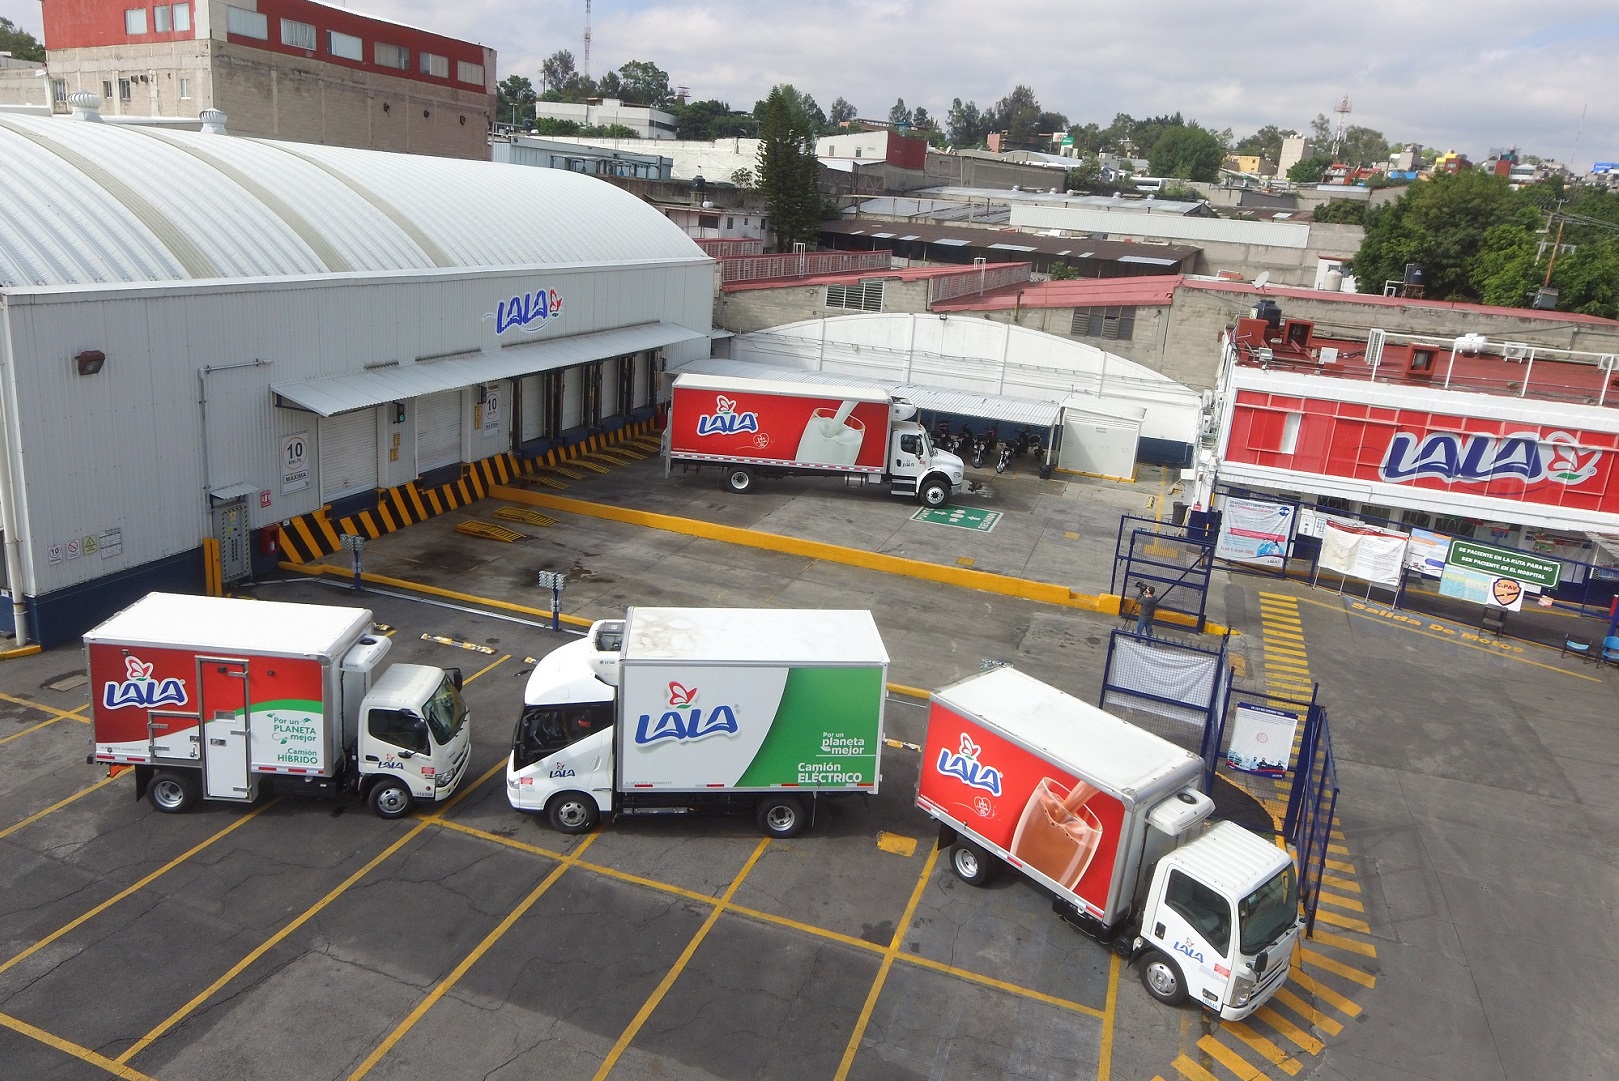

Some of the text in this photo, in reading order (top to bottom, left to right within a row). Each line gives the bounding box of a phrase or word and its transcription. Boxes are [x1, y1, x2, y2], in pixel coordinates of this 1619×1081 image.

[496, 288, 548, 335] LALA
[487, 398, 497, 411] 10
[698, 412, 758, 435] LALA
[287, 442, 303, 459] 10
[1382, 434, 1545, 480] LALA
[51, 547, 60, 555] 10
[1467, 549, 1493, 559] PACIENTE
[1474, 559, 1500, 569] PACIENTE
[1517, 569, 1546, 579] HOSPITAL
[1352, 602, 1524, 653] Salida De Motos
[105, 679, 187, 708] LALA
[274, 716, 287, 724] Por
[635, 705, 738, 744] LALA
[274, 724, 316, 735] PLANETA
[290, 734, 316, 743] mejor
[822, 737, 865, 747] planeta
[287, 747, 317, 756] Camión
[831, 746, 865, 756] mejor
[277, 752, 318, 764] HÍBRIDO
[378, 761, 404, 769] LALA
[797, 762, 841, 772] Camión
[549, 769, 576, 778] LALA
[797, 771, 863, 783] ELÉCTRICO
[938, 749, 1001, 795] LALA
[1173, 941, 1203, 963] LALA
